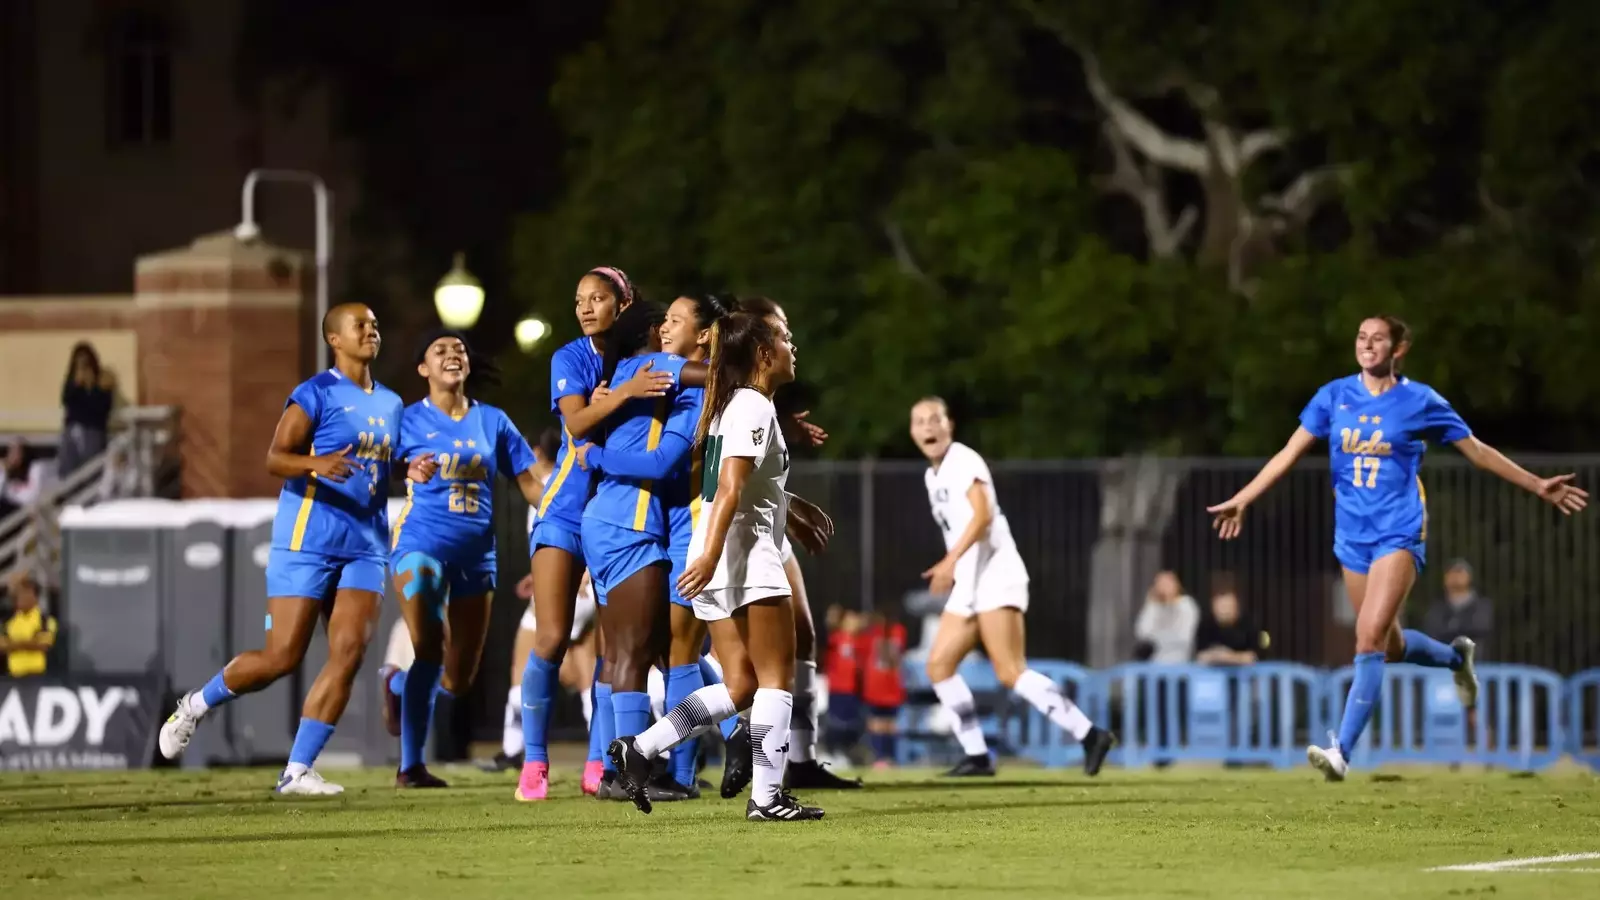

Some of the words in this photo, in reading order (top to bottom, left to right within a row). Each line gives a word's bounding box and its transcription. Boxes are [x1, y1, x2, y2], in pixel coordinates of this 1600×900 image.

[1340, 427, 1393, 456] Ucla
[1352, 456, 1381, 489] 17
[448, 482, 480, 513] 26
[0, 686, 123, 746] ADY
